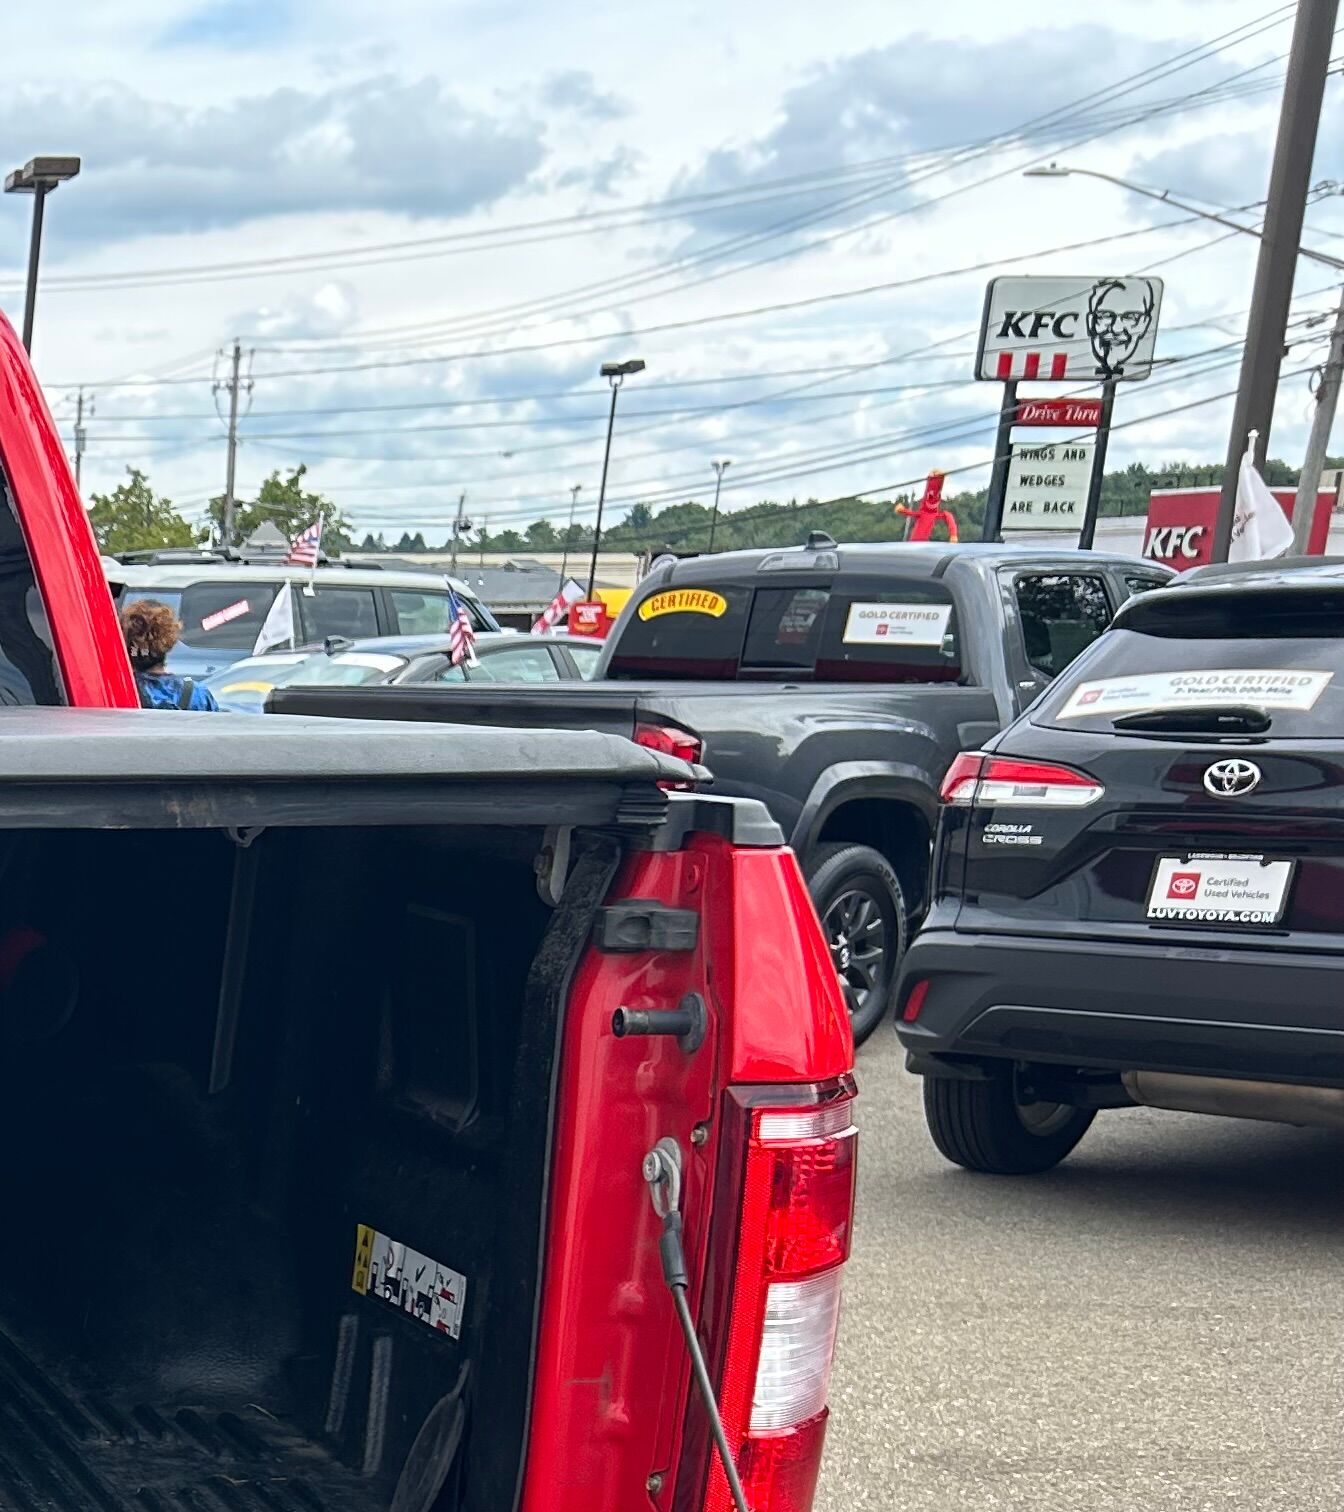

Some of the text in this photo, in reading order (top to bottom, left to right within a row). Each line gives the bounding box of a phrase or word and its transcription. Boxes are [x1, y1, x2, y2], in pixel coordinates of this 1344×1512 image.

[996, 311, 1080, 339] KFC
[1022, 405, 1098, 421] Drive Thru
[1020, 448, 1086, 461] WINGS AND
[1020, 474, 1065, 487] WEDGES
[1010, 501, 1075, 513] ARE BACK
[1144, 526, 1204, 559] KFC
[651, 592, 719, 613] CERTIFIED
[859, 610, 940, 620] GOLD CERTIFIED
[1170, 675, 1313, 686] GOLD CERTIFIED
[984, 824, 1032, 833] COROLLA
[983, 834, 1043, 845] CROSS
[1206, 877, 1250, 887] Certified
[1204, 889, 1270, 900] Used Vehicles
[1146, 907, 1276, 923] LUVTOYOTA.COM
